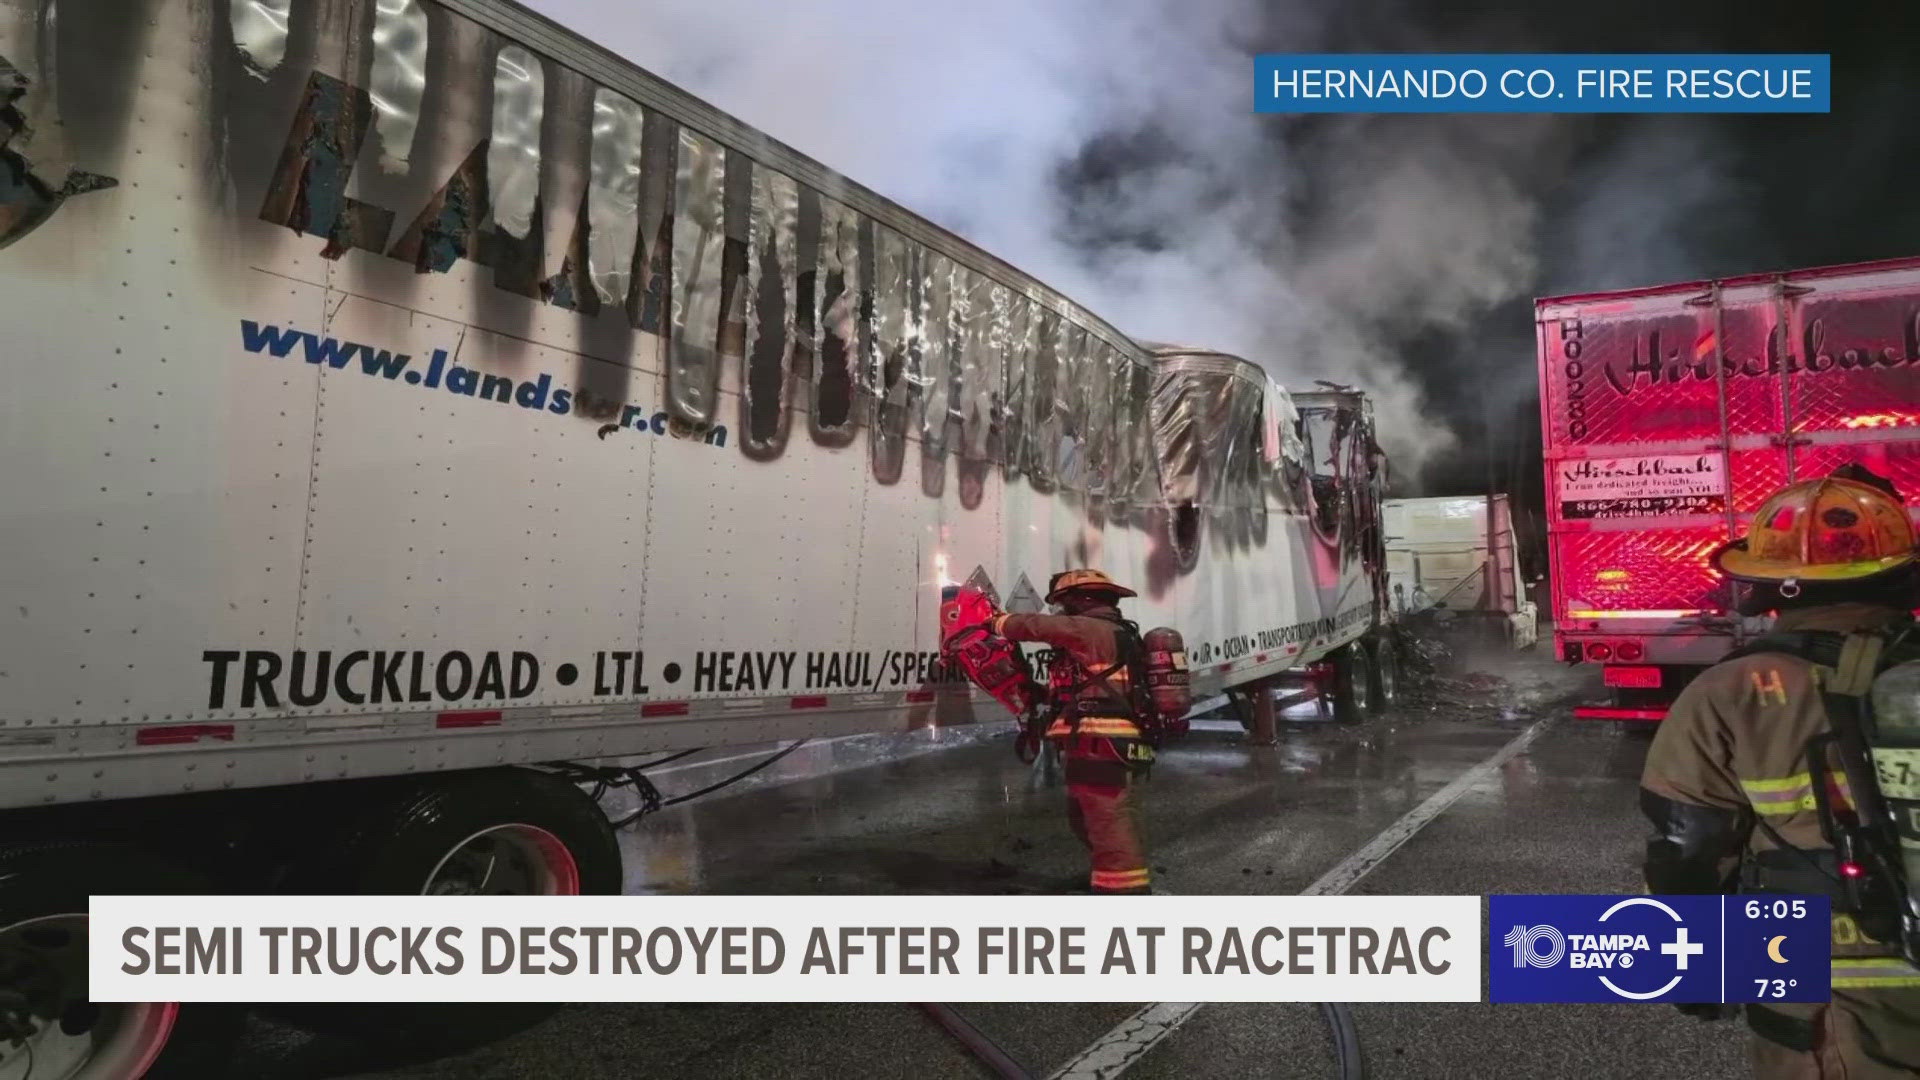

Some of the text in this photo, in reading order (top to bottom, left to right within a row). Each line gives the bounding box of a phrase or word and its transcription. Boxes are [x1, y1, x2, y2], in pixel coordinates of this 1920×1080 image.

[203, 650, 540, 710] TRUCKLOAD
[594, 651, 649, 696] LTL
[694, 651, 797, 692] HEAVY
